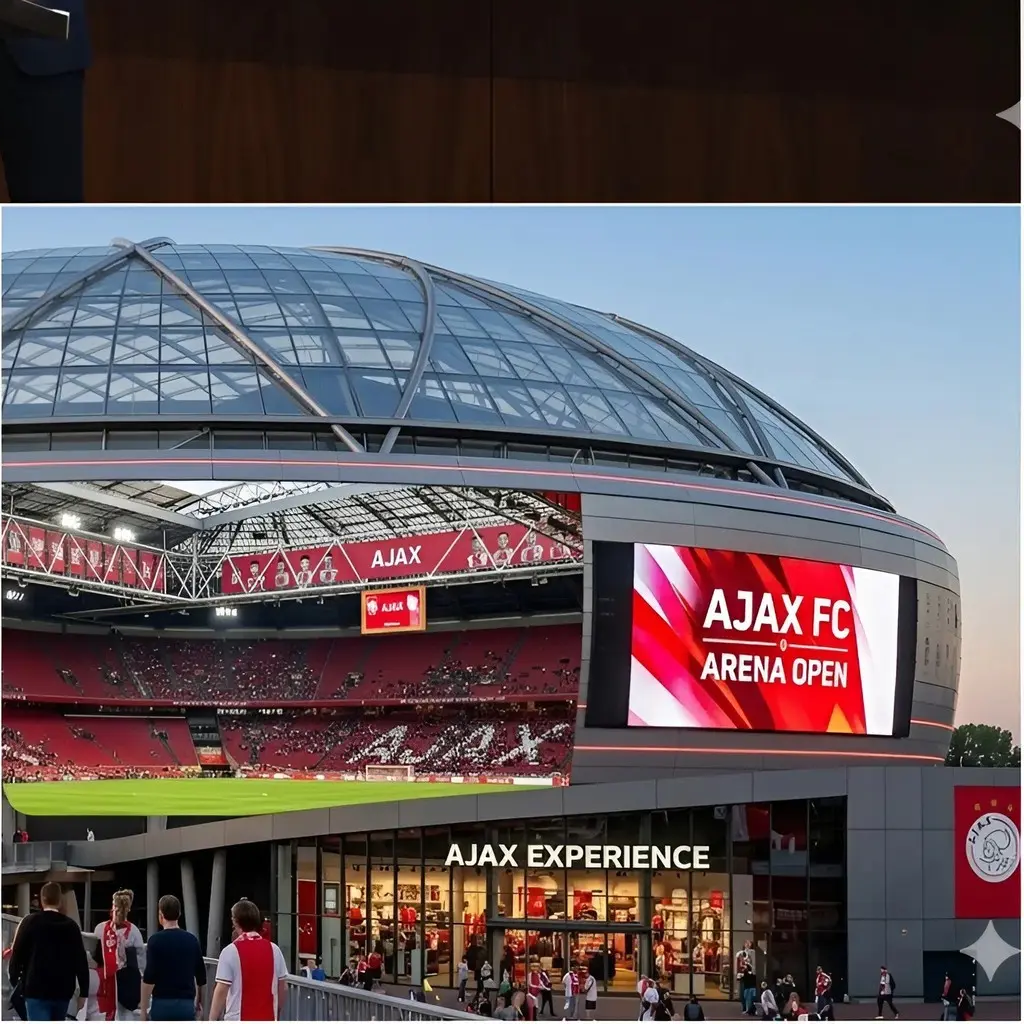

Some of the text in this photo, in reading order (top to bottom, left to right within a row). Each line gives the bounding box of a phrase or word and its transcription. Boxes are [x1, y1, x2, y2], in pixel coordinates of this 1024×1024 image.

[371, 545, 422, 569] AJAX
[702, 588, 851, 639] AJAX FC
[700, 652, 848, 689] ARENA OPEN
[444, 843, 711, 869] AJAX EXPERIENCE
